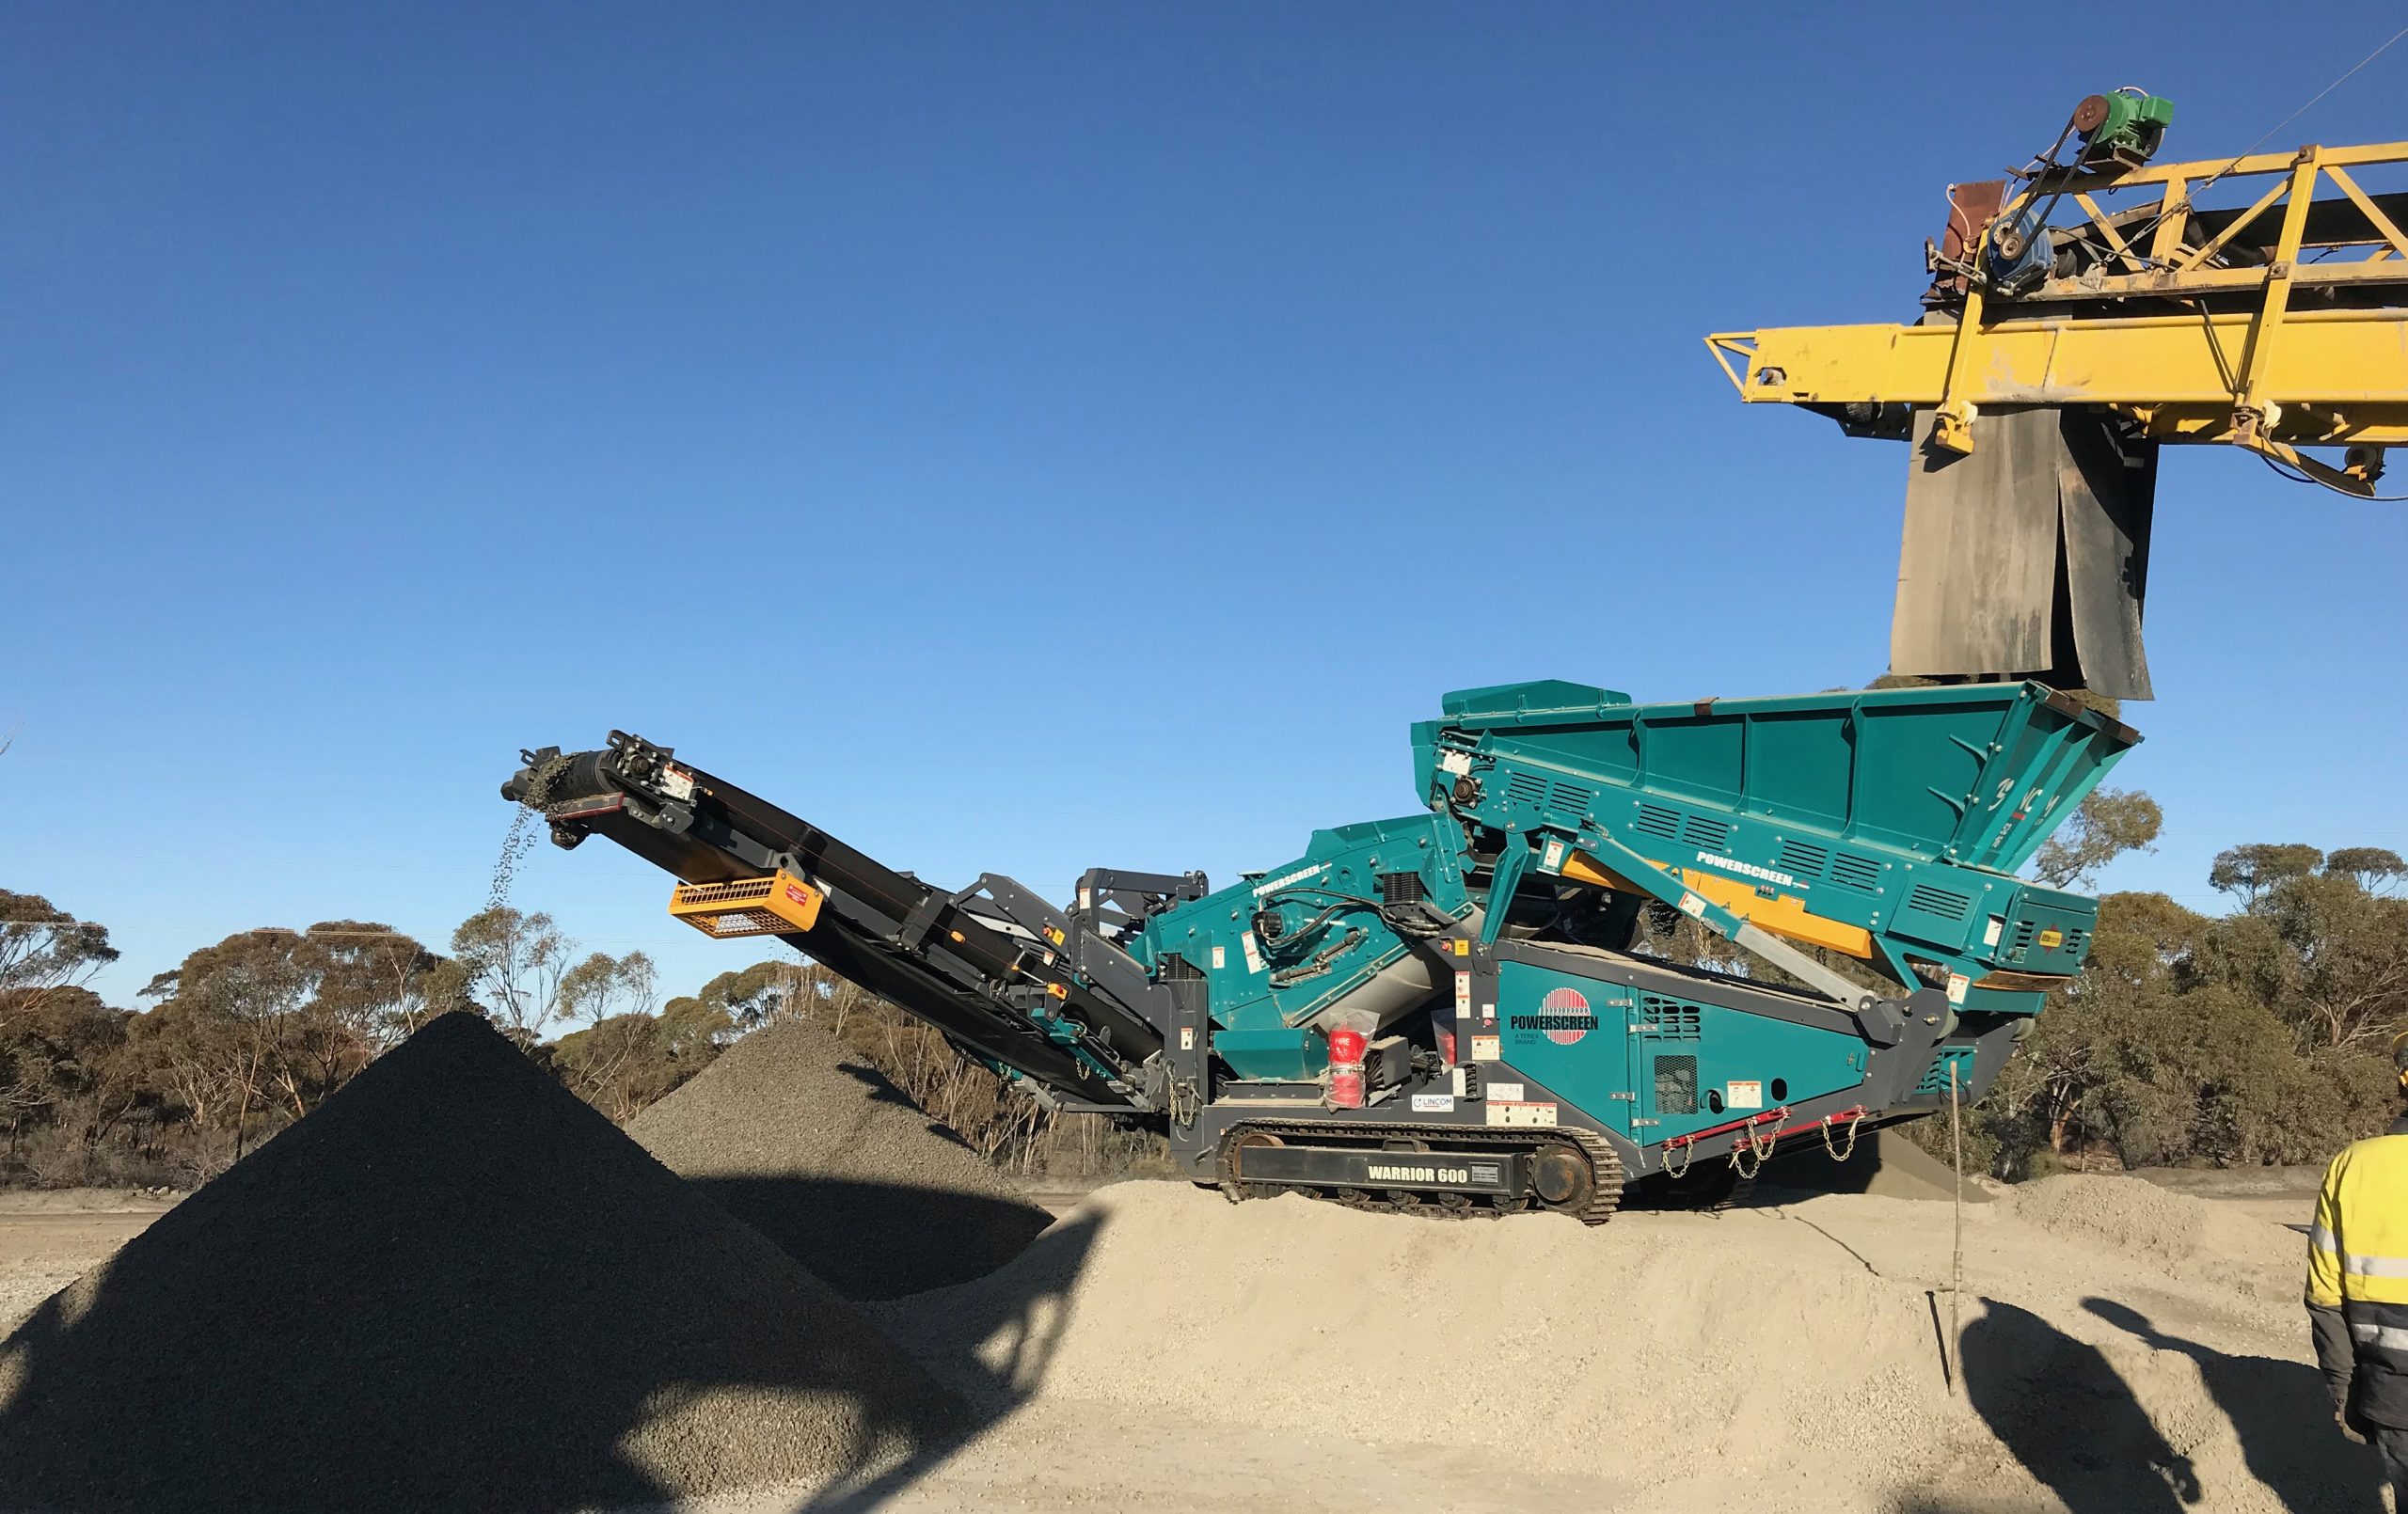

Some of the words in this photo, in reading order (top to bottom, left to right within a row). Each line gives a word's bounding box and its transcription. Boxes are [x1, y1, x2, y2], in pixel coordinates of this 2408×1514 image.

[1696, 851, 1793, 887] POWERSCREEN
[1252, 864, 1321, 898] POWERSCREEN
[1511, 1016, 1599, 1031] POWERSCREEN
[1423, 1097, 1452, 1106] LINCOM
[1368, 1165, 1435, 1182] WARRIOR
[1437, 1168, 1468, 1184] 600
